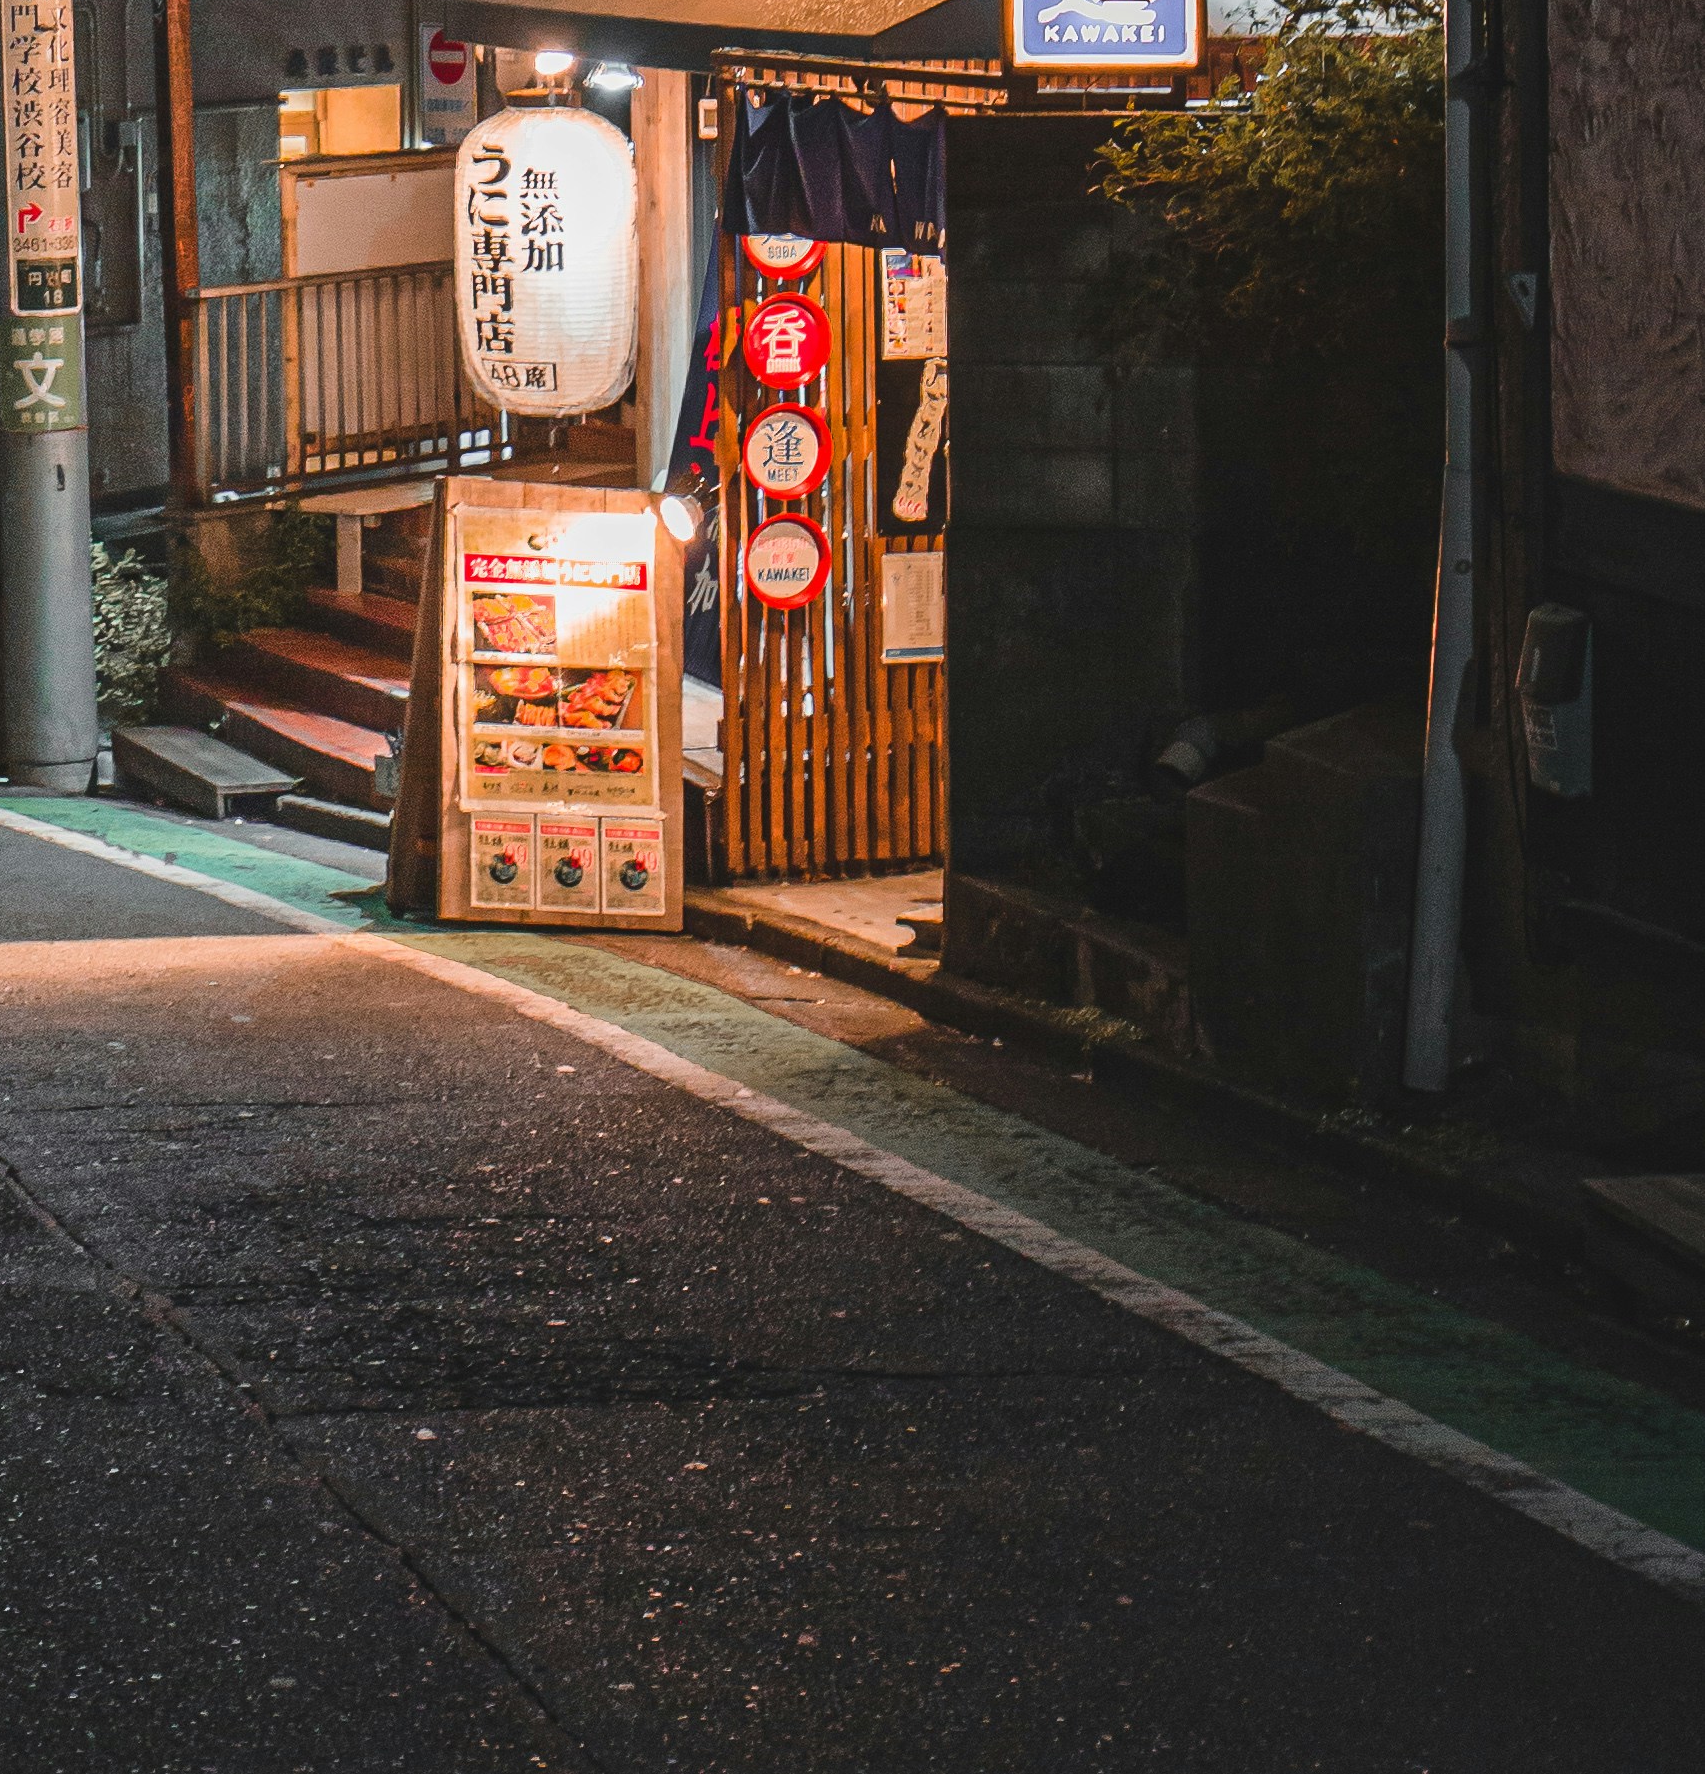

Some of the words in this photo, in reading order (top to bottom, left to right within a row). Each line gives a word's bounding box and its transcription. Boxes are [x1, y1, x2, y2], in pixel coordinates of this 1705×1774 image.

[1044, 24, 1165, 43] KAWAKEI
[520, 167, 565, 273] 無添加
[466, 145, 515, 354] うに専門店
[761, 309, 807, 358] 呑
[13, 351, 66, 409] 文
[767, 468, 799, 482] MEET
[758, 567, 810, 582] KAWAKEI
